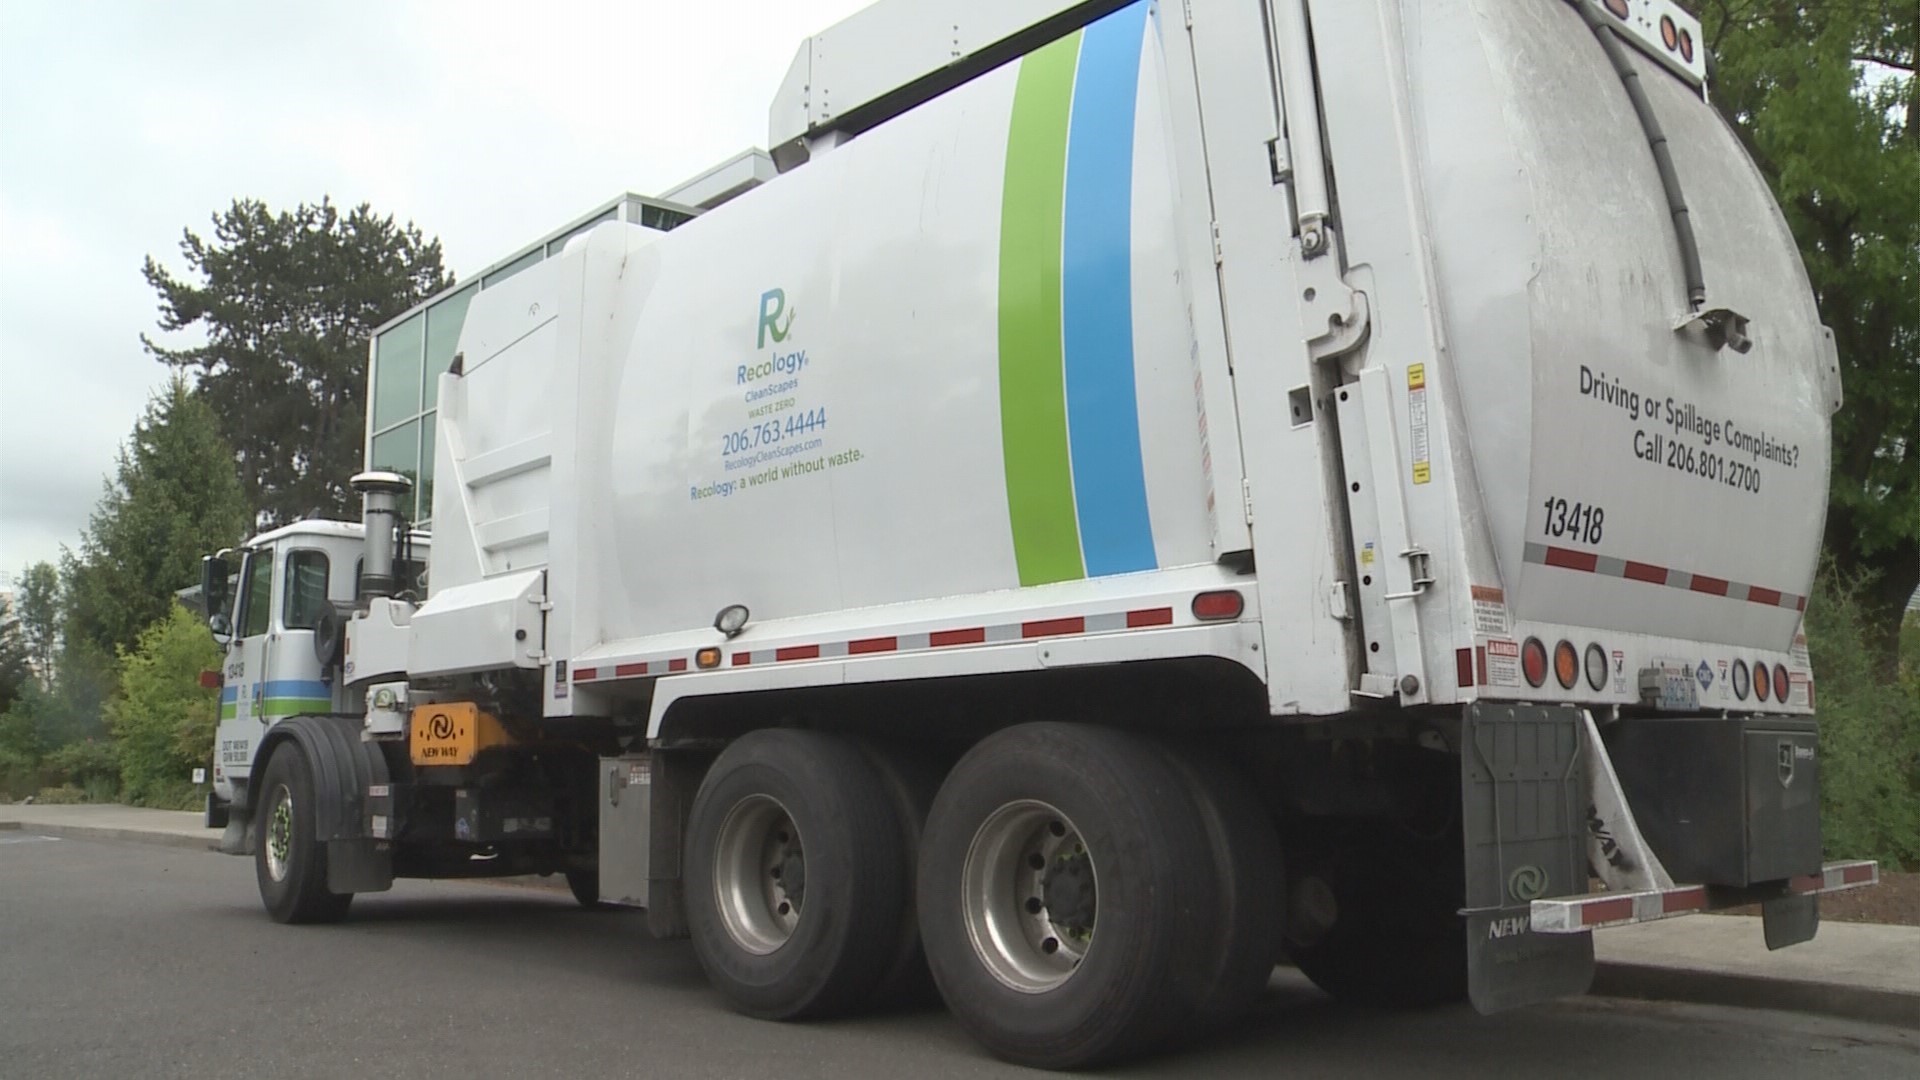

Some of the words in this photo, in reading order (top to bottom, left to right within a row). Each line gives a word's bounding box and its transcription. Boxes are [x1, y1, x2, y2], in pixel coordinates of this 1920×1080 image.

[745, 378, 799, 403] CleanScapes
[749, 405, 773, 419] WASTE
[775, 397, 795, 413] ZERO
[722, 406, 827, 456] 206.763.4444
[1580, 365, 1640, 421] Driving
[1645, 397, 1661, 420] or
[1666, 397, 1721, 446] Spillage
[1724, 420, 1800, 469] Complaints?
[690, 480, 738, 501] Recology:
[739, 477, 746, 489] a
[749, 468, 779, 487] world
[781, 456, 825, 483] without
[828, 449, 864, 470] waste.
[724, 437, 823, 472] RecologyCleanScapes.com
[1633, 429, 1663, 465] Call
[1667, 440, 1761, 494] 206.801.2700
[1544, 496, 1604, 545] 13418
[422, 746, 439, 758] NEW
[441, 746, 459, 758] WAY
[1489, 916, 1530, 940] NEW
